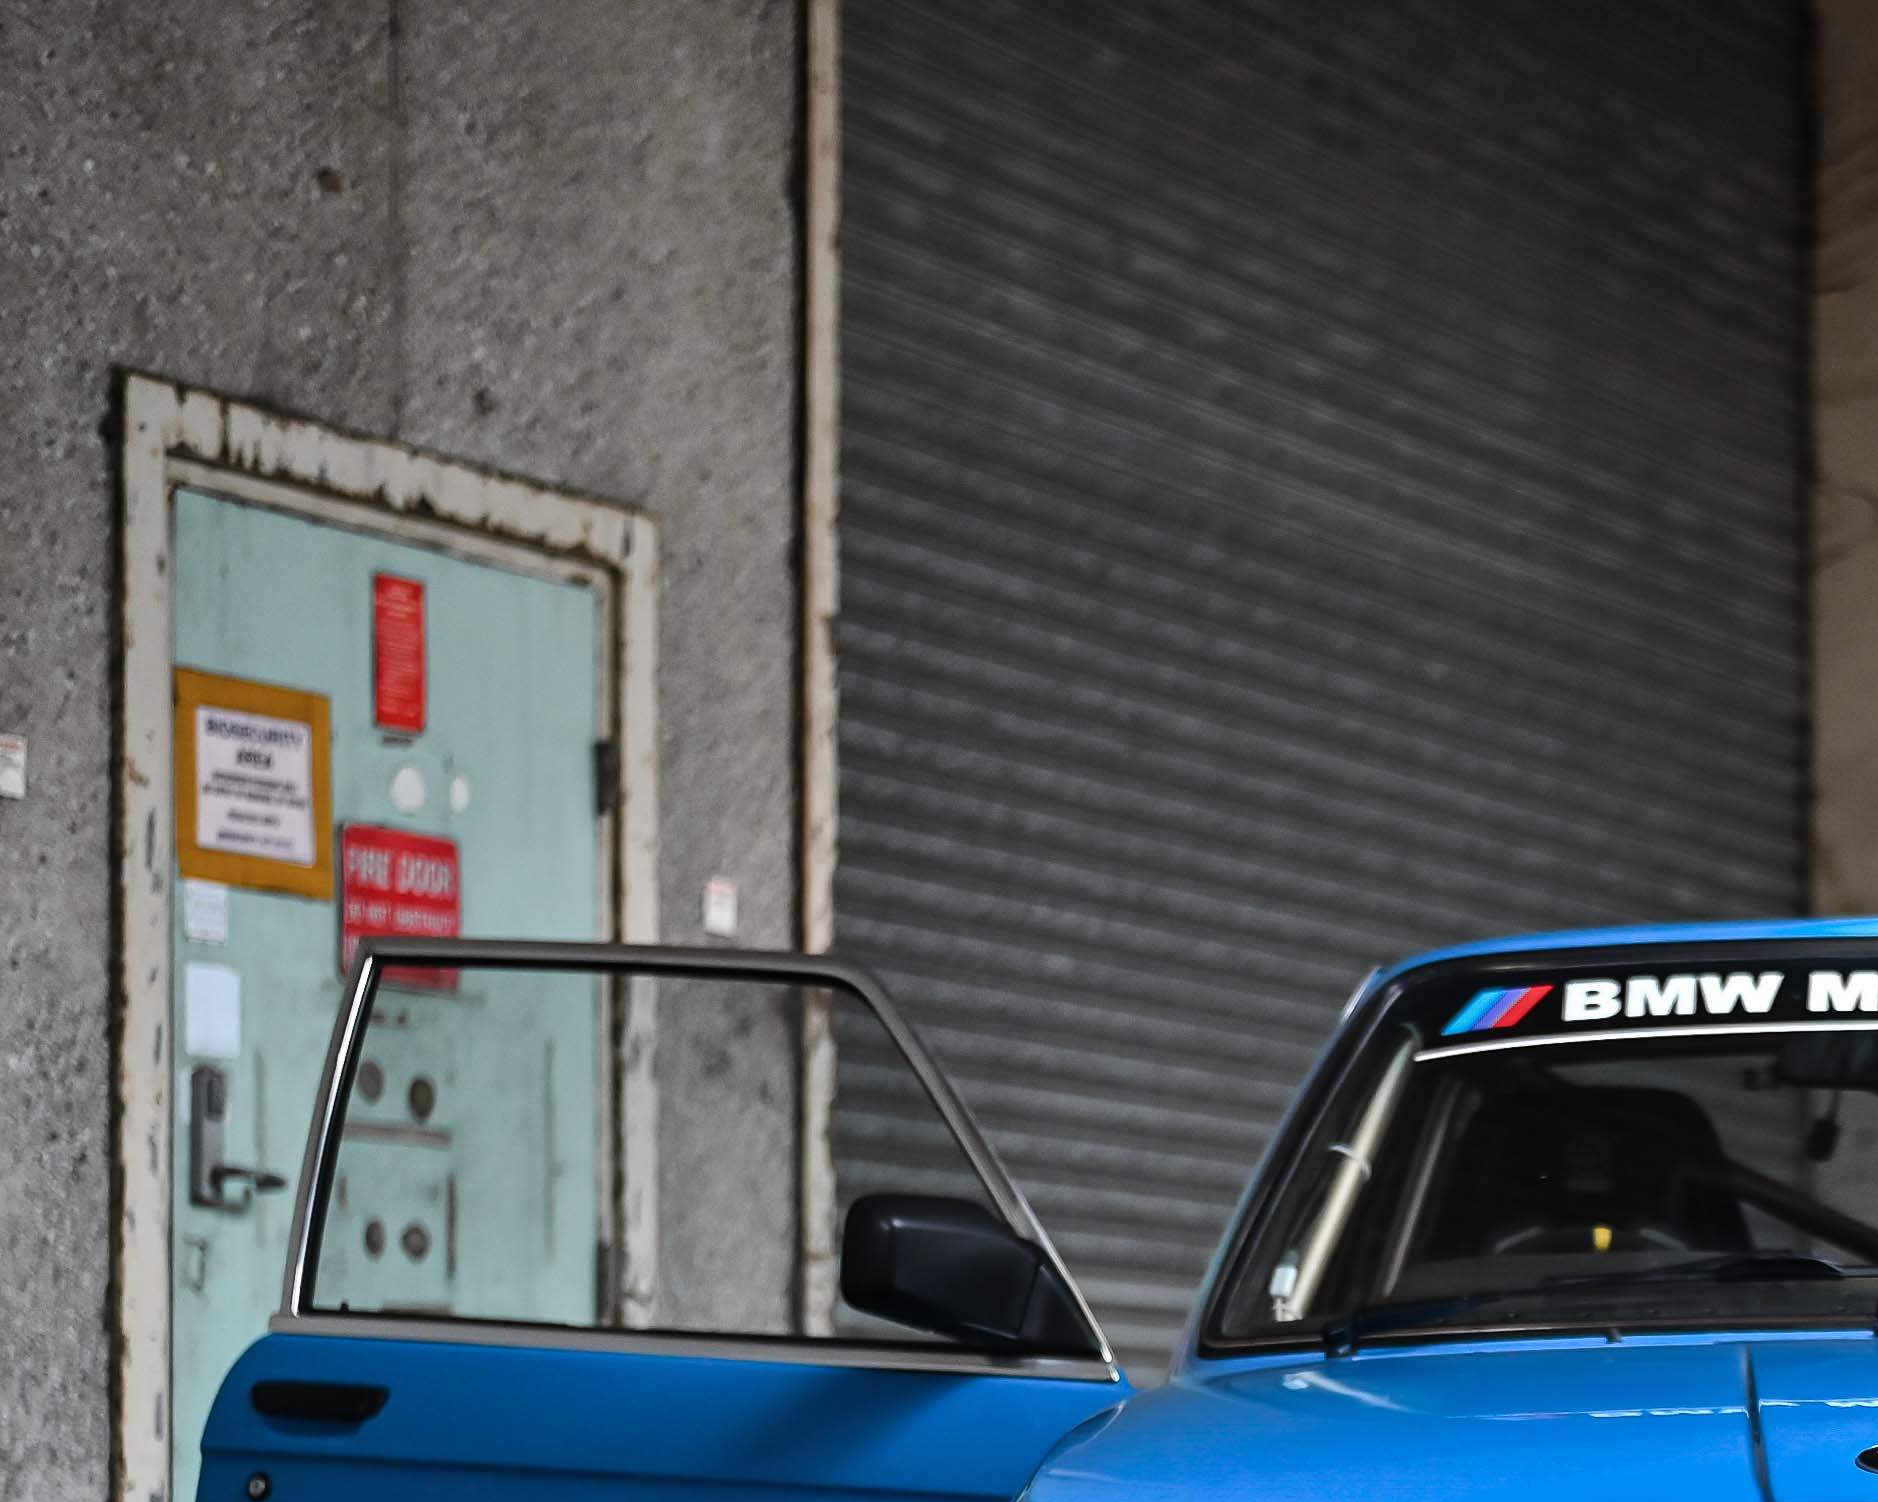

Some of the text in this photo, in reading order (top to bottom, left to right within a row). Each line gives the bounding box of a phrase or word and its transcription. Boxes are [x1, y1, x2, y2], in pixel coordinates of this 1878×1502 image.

[348, 845, 454, 897] FIRE DOOR
[1562, 971, 1784, 1022] BMW
